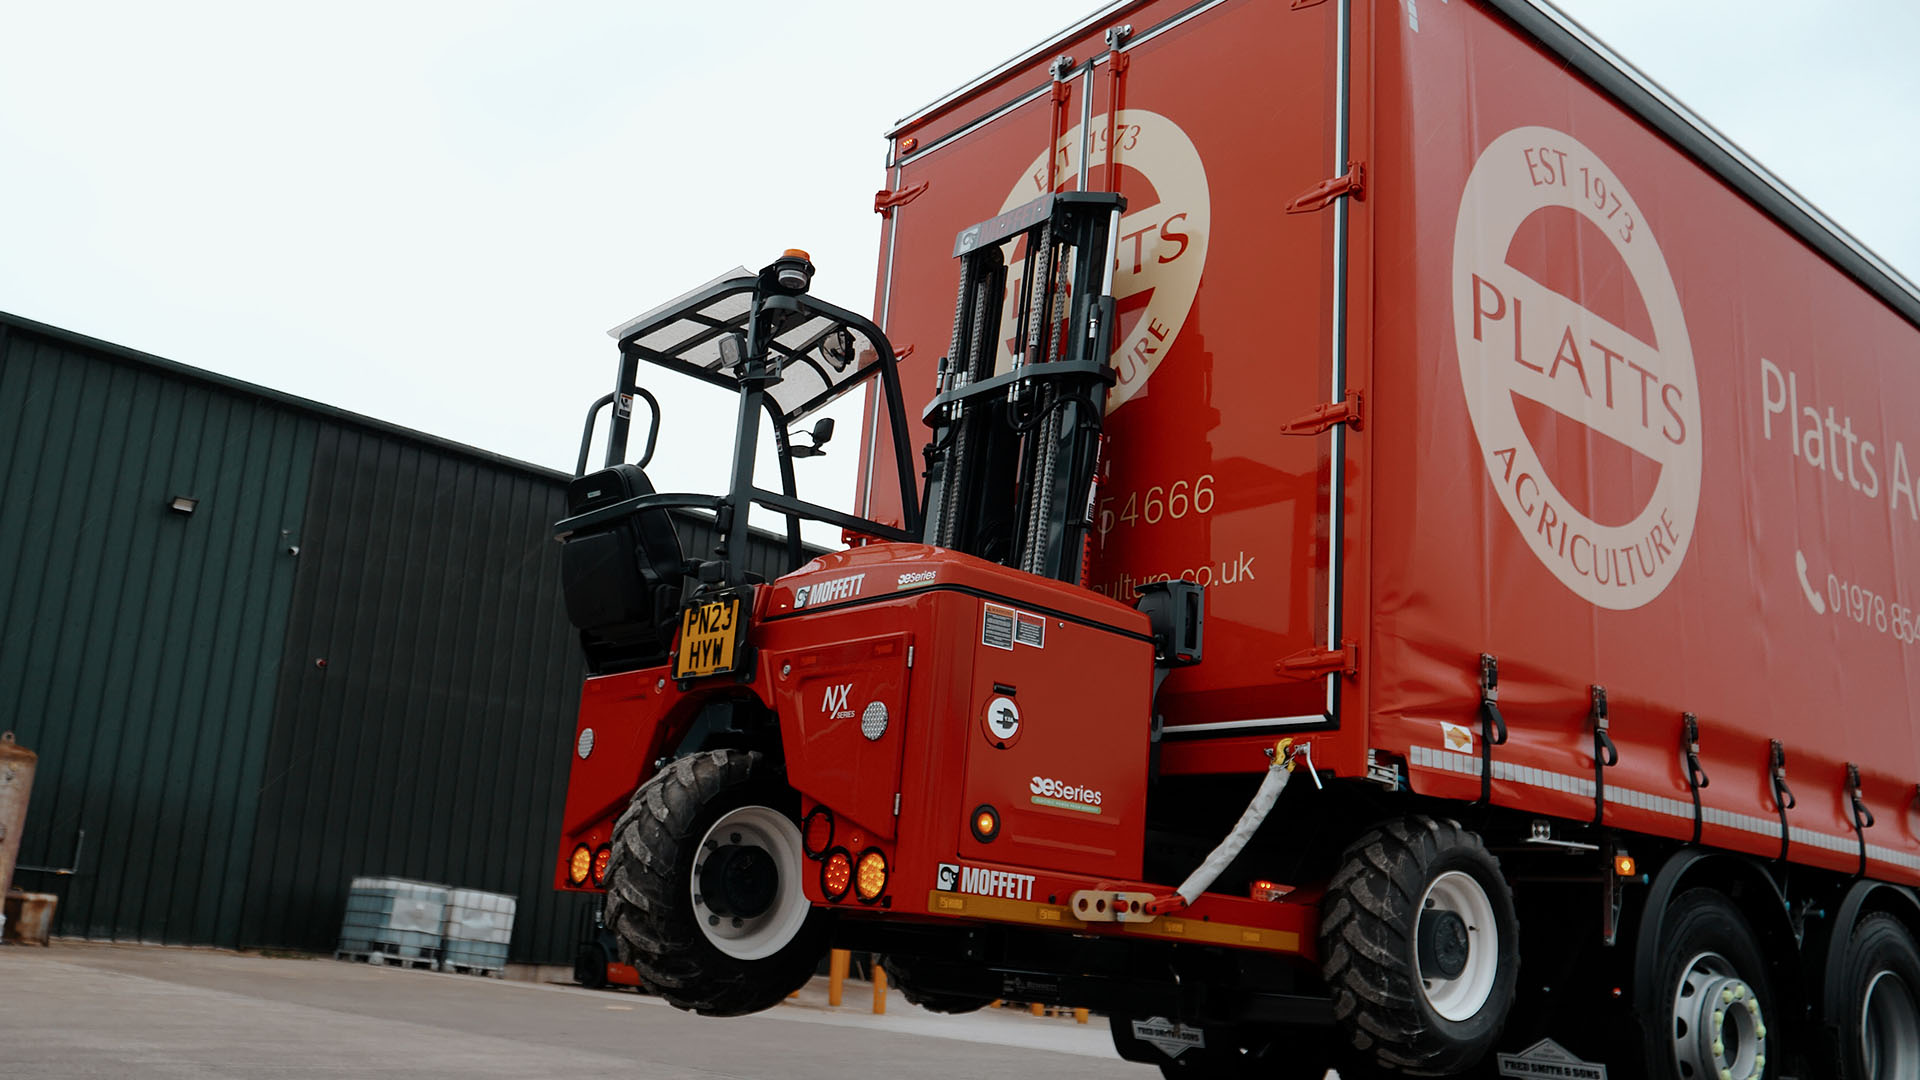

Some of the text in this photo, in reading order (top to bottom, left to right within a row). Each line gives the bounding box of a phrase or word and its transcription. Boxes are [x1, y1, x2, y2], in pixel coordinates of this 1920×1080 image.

[1523, 146, 1635, 244] EST 1973
[1471, 272, 1687, 446] PLATTS
[1760, 357, 1920, 521] Platts A
[1493, 446, 1680, 588] AGRICULTURE
[808, 573, 866, 606] MOFFETT
[1827, 573, 1888, 633] 01978
[687, 602, 734, 637] PN23
[689, 637, 724, 670] HYW
[821, 683, 853, 720] NX
[961, 866, 1036, 901] MOFFETT
